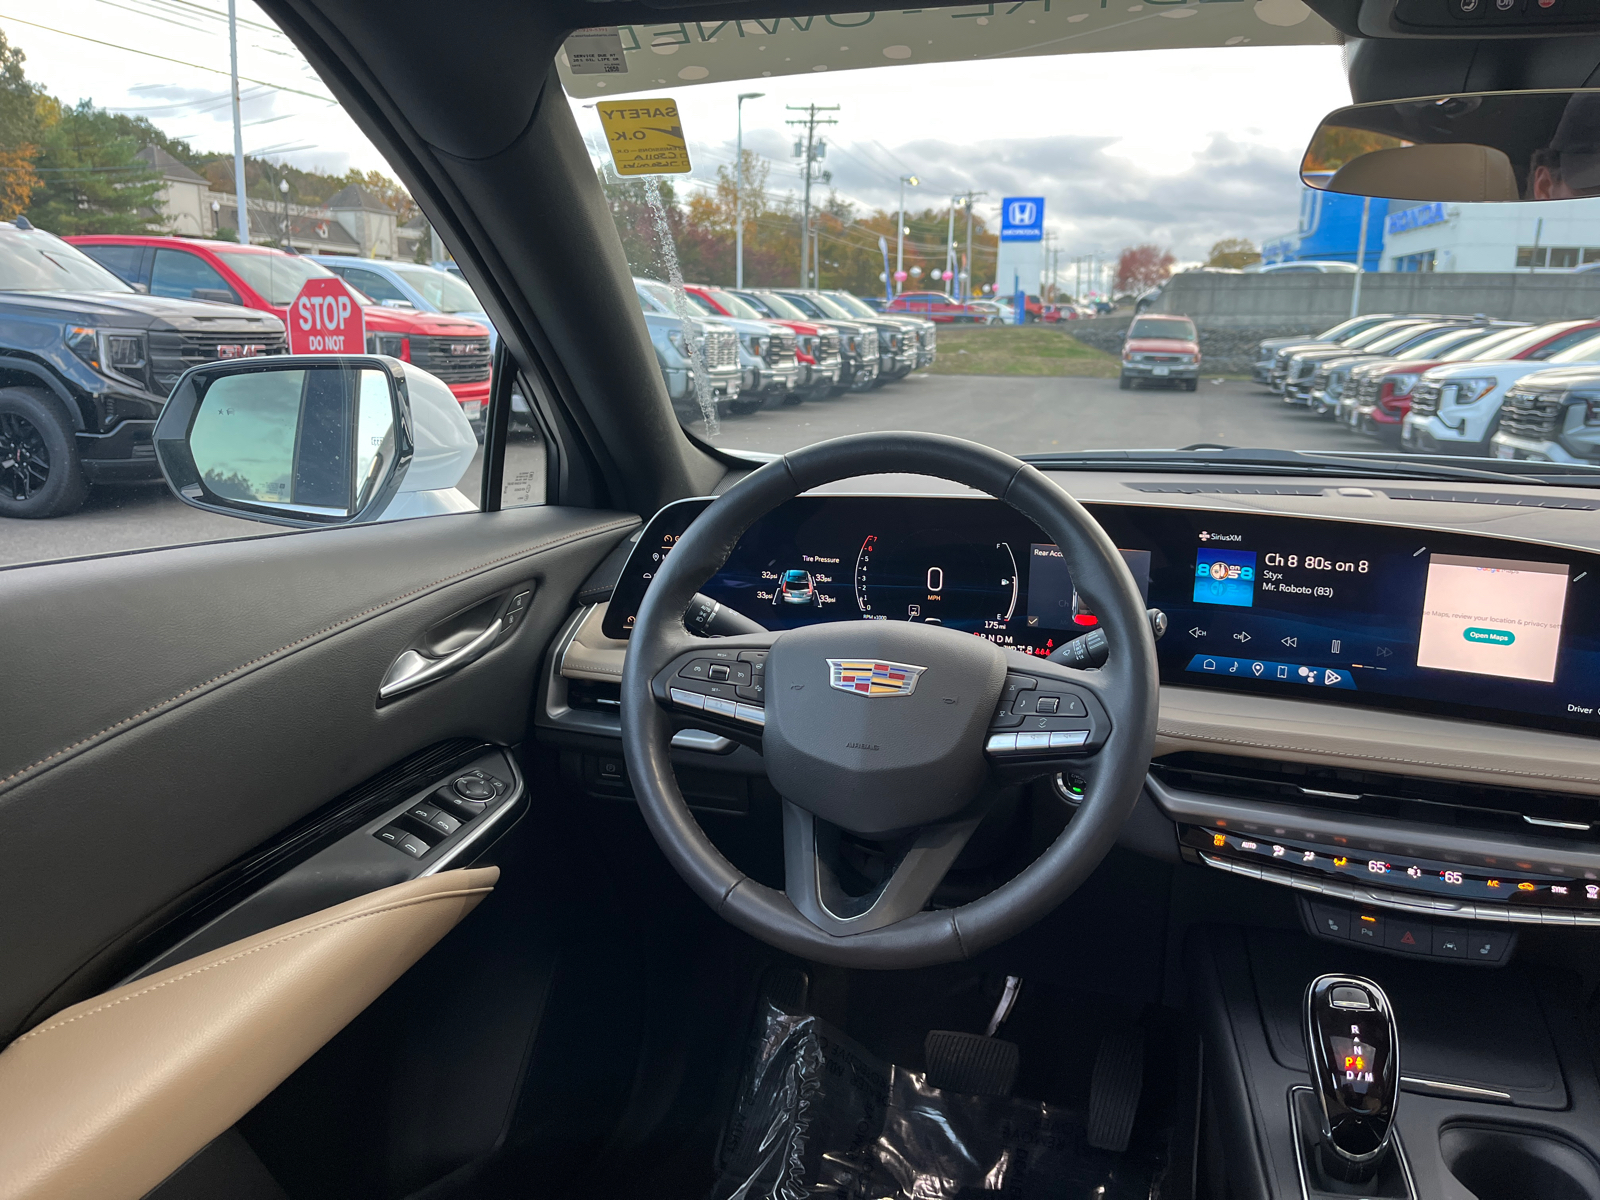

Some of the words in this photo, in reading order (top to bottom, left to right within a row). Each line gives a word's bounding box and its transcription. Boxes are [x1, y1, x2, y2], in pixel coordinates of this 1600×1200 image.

[298, 296, 351, 331] STOP
[309, 336, 324, 351] DO
[326, 336, 345, 351] NOT
[216, 345, 266, 358] GMC
[451, 344, 480, 356] GMC
[1210, 533, 1242, 542] SiriusXM
[815, 555, 840, 563] Pressure
[1265, 553, 1284, 566] Ch
[1288, 555, 1298, 567] 8
[1305, 556, 1332, 570] 80s
[1335, 561, 1354, 572] on
[1358, 560, 1369, 573] 8
[927, 566, 943, 592] 0
[1263, 570, 1283, 581] Styx
[1262, 582, 1277, 592] Mr.
[1279, 584, 1312, 595] Roboto
[1313, 586, 1334, 598] (83)
[1489, 616, 1516, 624] location
[1523, 620, 1548, 628] privacy
[997, 635, 1004, 643] D
[1490, 633, 1508, 642] Maps
[1567, 704, 1593, 714] Driver
[846, 742, 880, 751] AIRBAG
[1242, 841, 1257, 849] AUTO
[1368, 861, 1386, 873] 65
[1444, 871, 1463, 884] 65
[1487, 880, 1499, 888] A/C
[1551, 886, 1568, 894] SYNC
[1351, 1025, 1360, 1034] R
[1353, 1046, 1362, 1054] N
[1345, 1057, 1353, 1067] P
[1346, 1071, 1353, 1079] D
[1365, 1072, 1374, 1082] M
